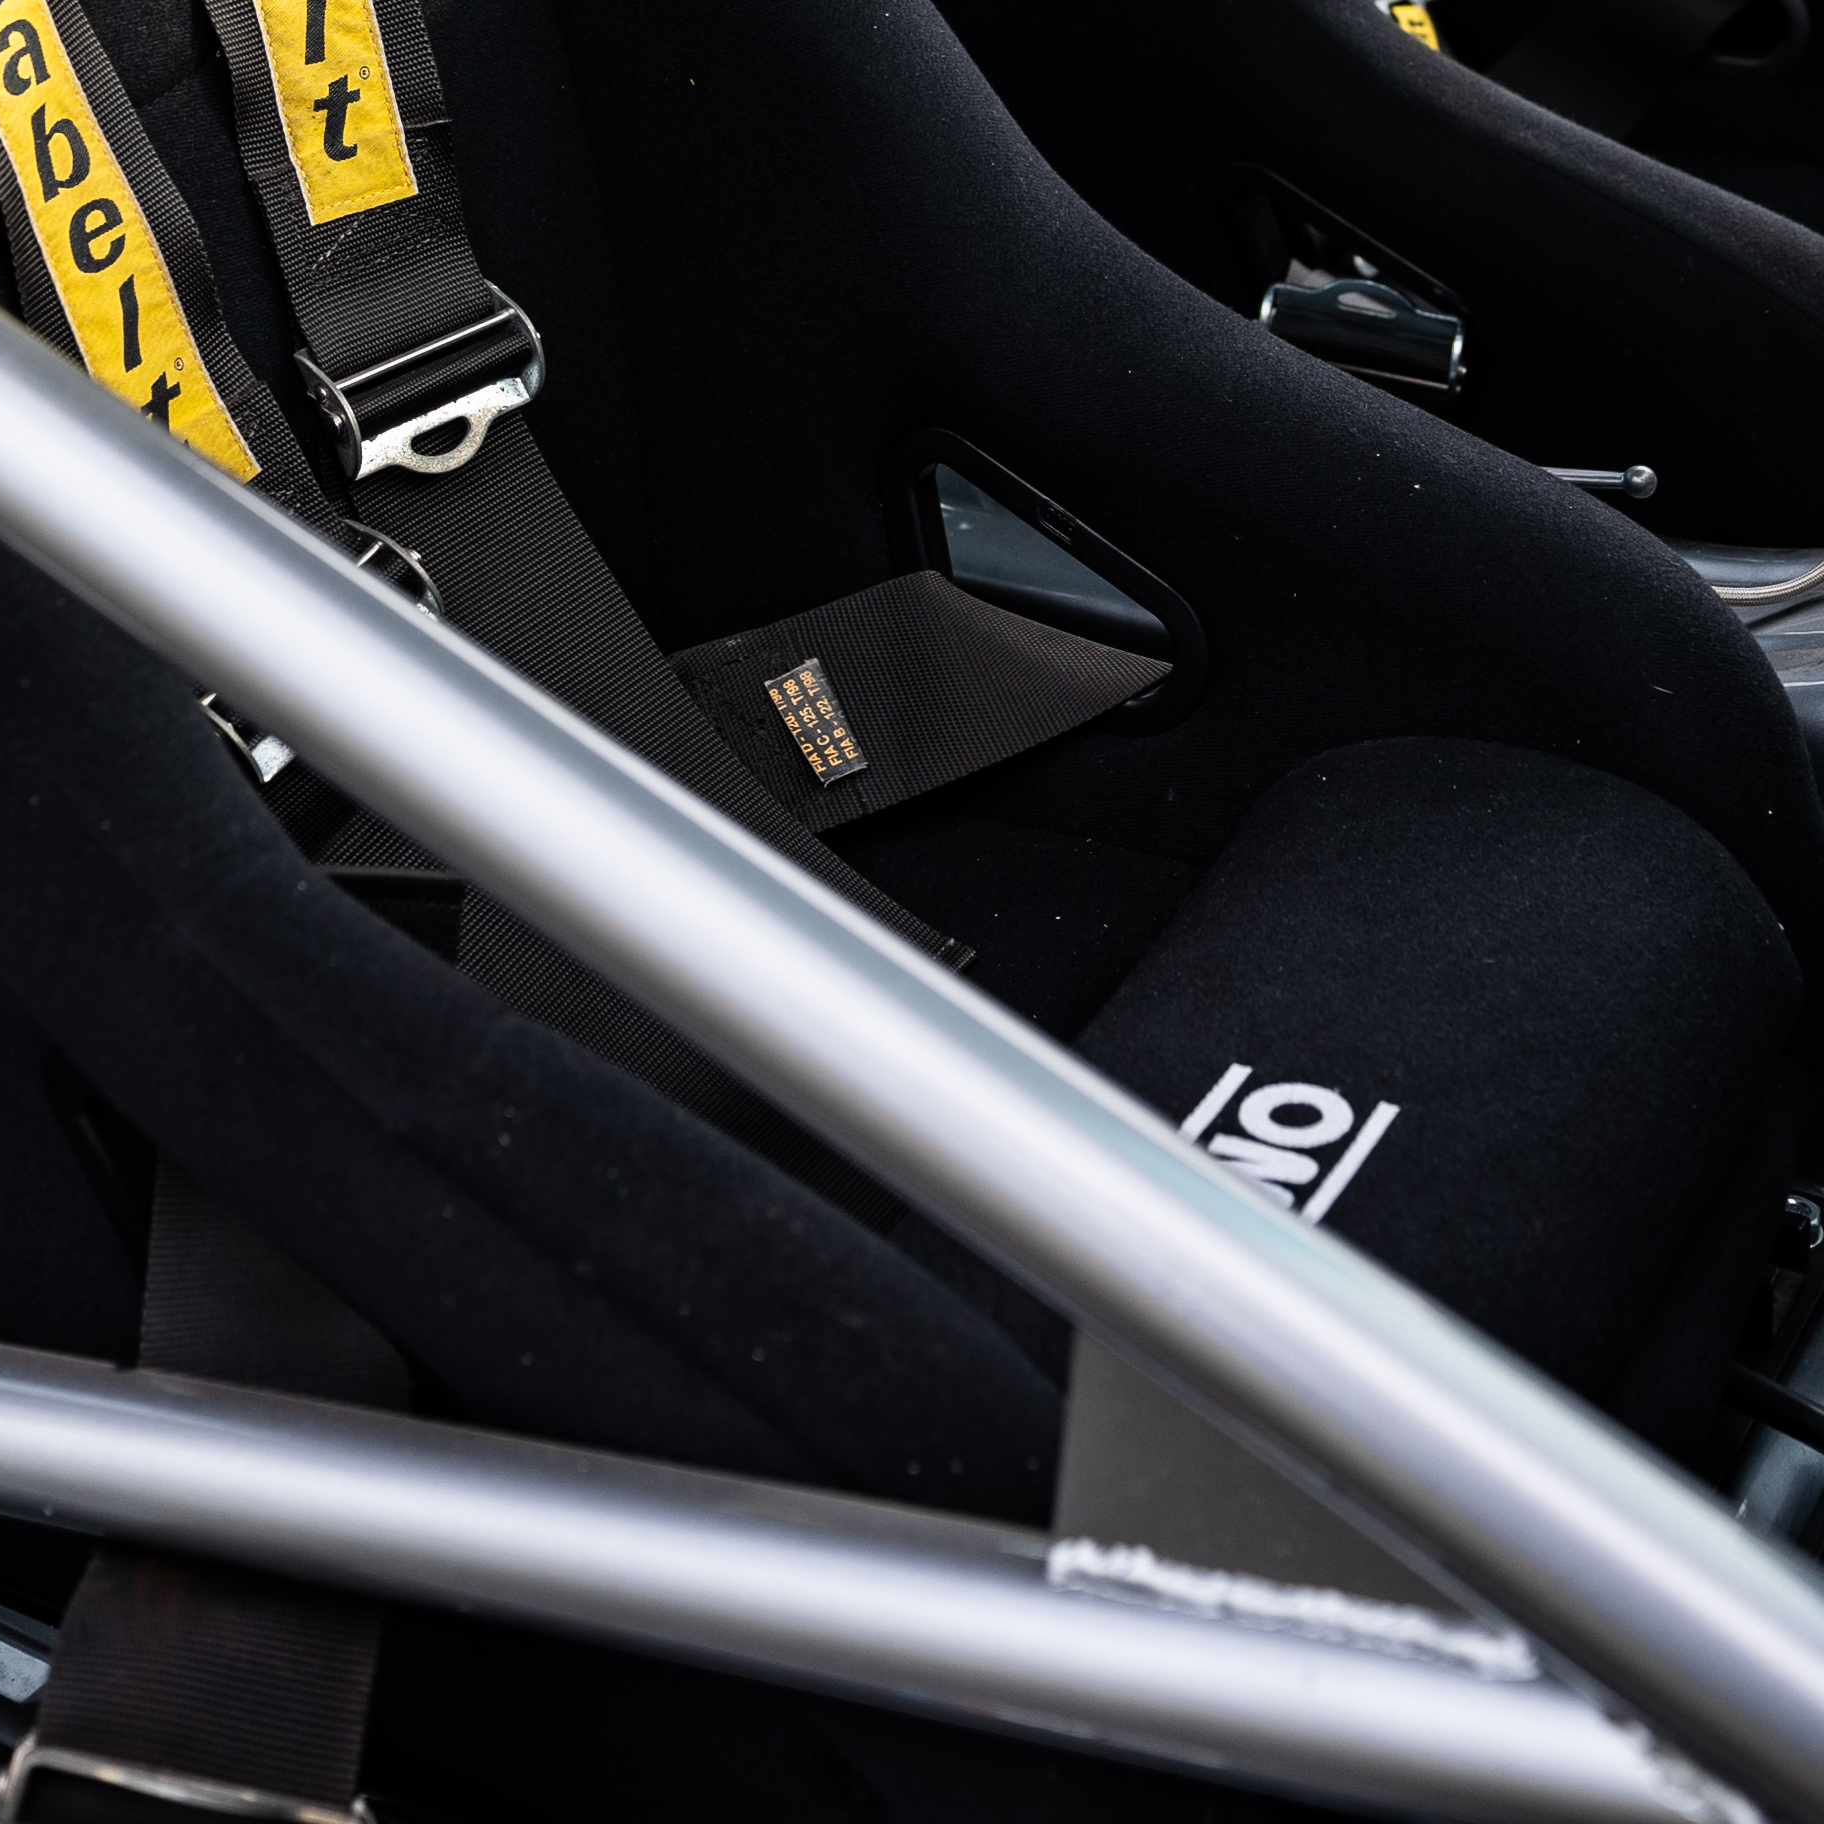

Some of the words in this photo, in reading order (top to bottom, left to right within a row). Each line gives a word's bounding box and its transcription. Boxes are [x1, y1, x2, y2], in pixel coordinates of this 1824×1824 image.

[782, 678, 803, 706] T/98
[799, 670, 820, 697] T/98
[799, 703, 818, 728] 125.
[816, 734, 830, 746] C
[832, 726, 847, 739] B
[823, 745, 843, 767] FIA
[839, 737, 859, 760] FIA
[807, 752, 827, 774] FIA
[1207, 1081, 1355, 1210] OM
